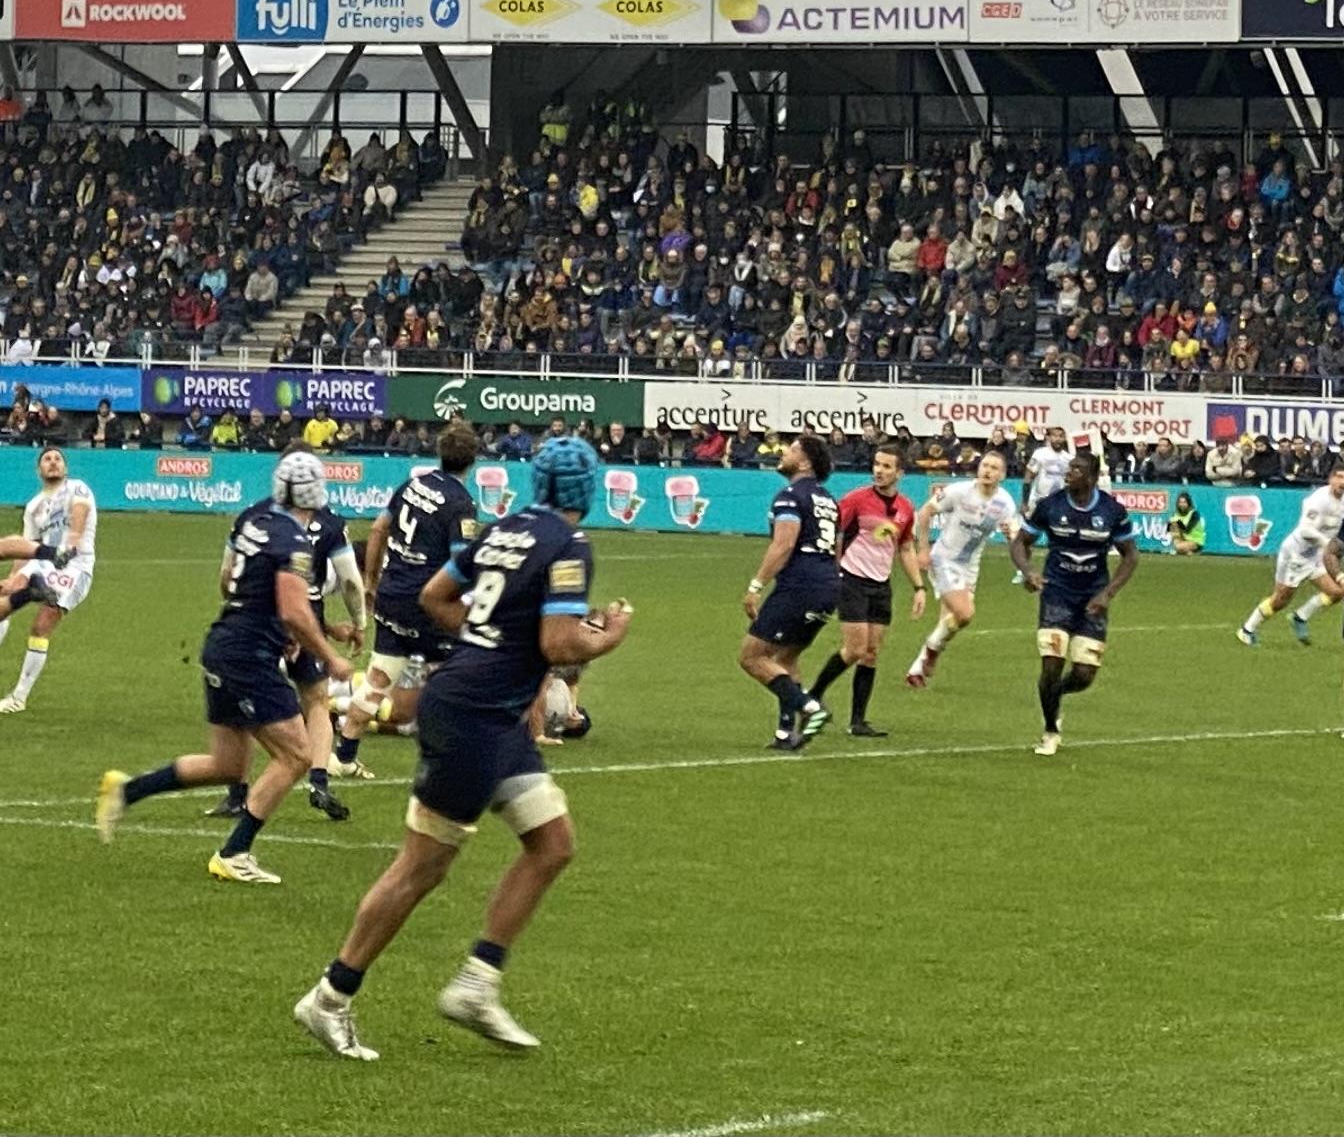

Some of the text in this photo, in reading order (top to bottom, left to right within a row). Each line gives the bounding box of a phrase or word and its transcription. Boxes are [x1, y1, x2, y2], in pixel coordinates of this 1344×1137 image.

[89, 3, 186, 21] ROCKWOOL
[499, 0, 545, 13] COLAS
[616, 0, 664, 13] COLAS
[777, 5, 965, 31] ACTEMIUM
[184, 376, 251, 397] PAPREC
[307, 379, 375, 400] PAPREC
[480, 387, 596, 415] Groupama
[1070, 398, 1164, 415] CLERMONT
[657, 405, 768, 429] accenture
[791, 404, 905, 430] accenture
[1133, 419, 1192, 437] SPORT
[159, 460, 209, 474] ANDROS
[1116, 494, 1165, 509] NDROS
[399, 504, 418, 545] 4
